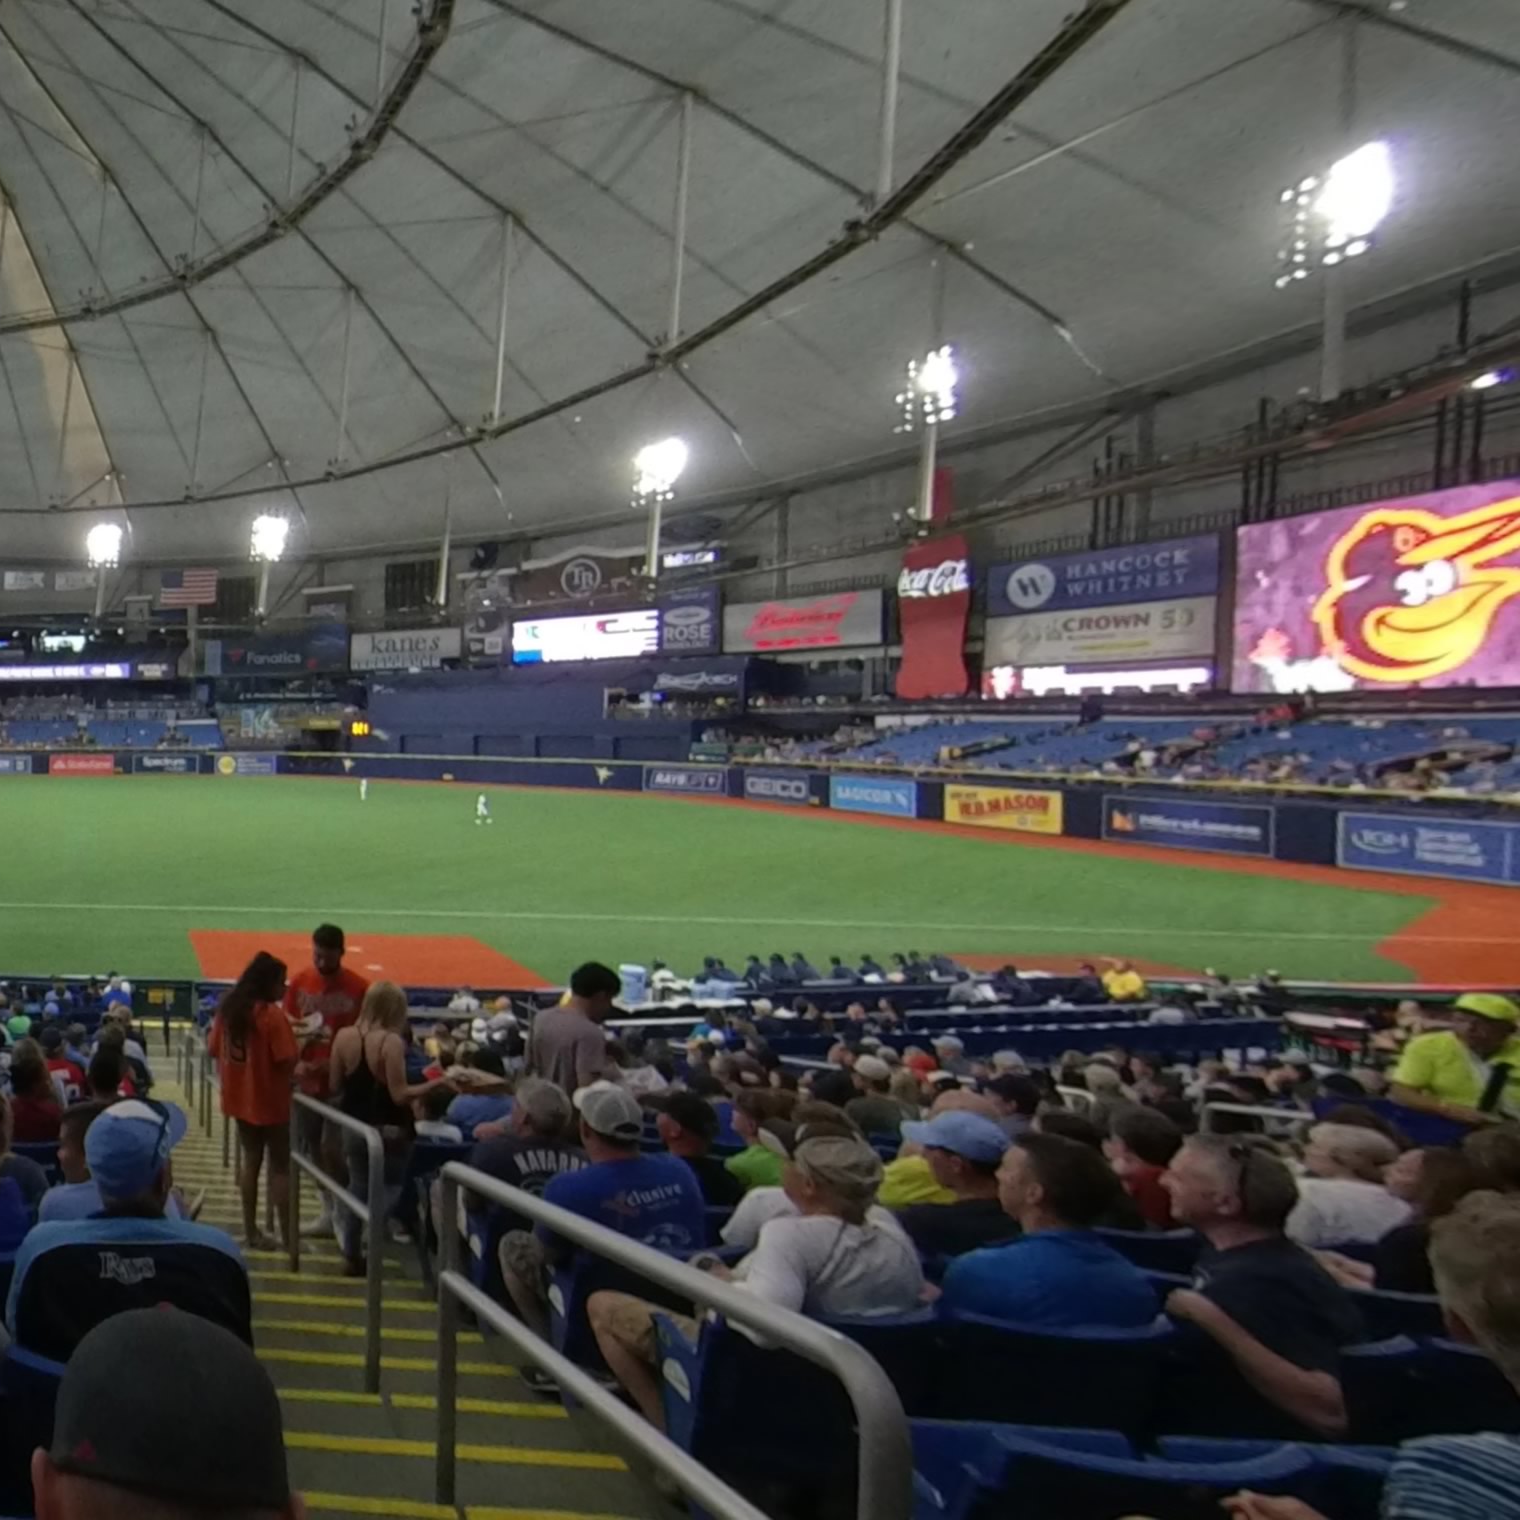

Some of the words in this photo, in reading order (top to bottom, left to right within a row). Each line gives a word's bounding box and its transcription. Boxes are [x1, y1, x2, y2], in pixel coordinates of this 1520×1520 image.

[1066, 546, 1190, 580] HANCOCK
[1066, 567, 1189, 597] WHITNEY
[663, 623, 712, 641] ROSE
[1062, 611, 1151, 633] CROWN
[370, 633, 441, 654] kanes
[246, 650, 303, 666] Fanatics
[745, 776, 808, 799] GEICO
